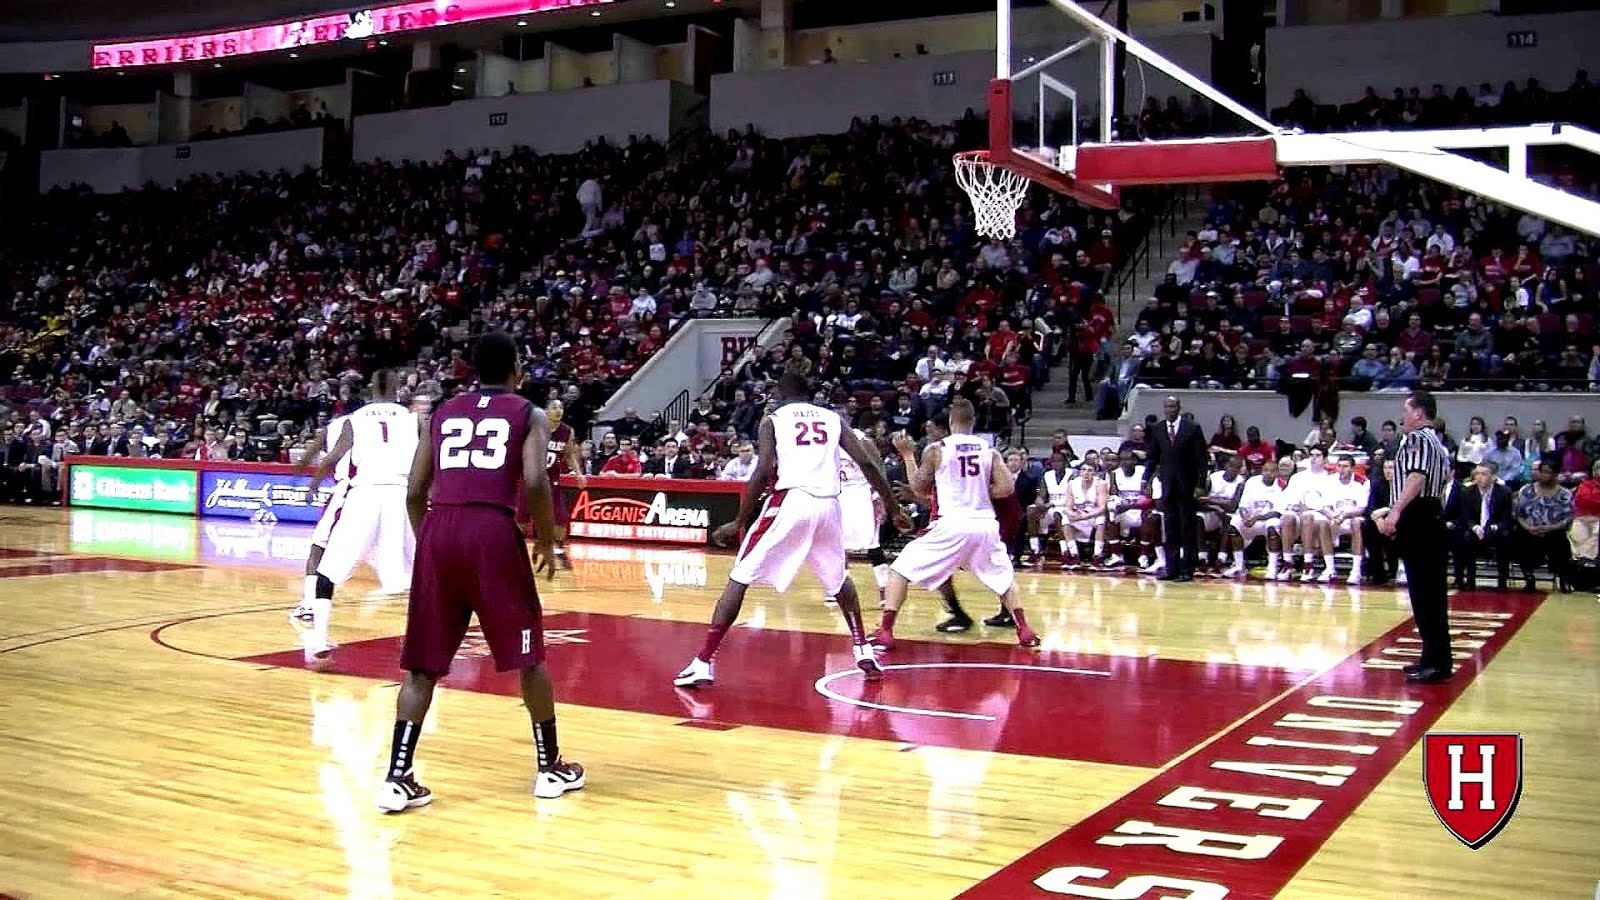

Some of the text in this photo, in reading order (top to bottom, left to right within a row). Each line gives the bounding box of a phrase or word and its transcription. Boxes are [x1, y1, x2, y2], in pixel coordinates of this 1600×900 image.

[378, 421, 388, 443] 1
[439, 417, 512, 470] 23
[794, 421, 828, 446] 25
[957, 454, 980, 477] 15
[571, 490, 709, 527] AGGANIS ARENA
[521, 629, 531, 655] H
